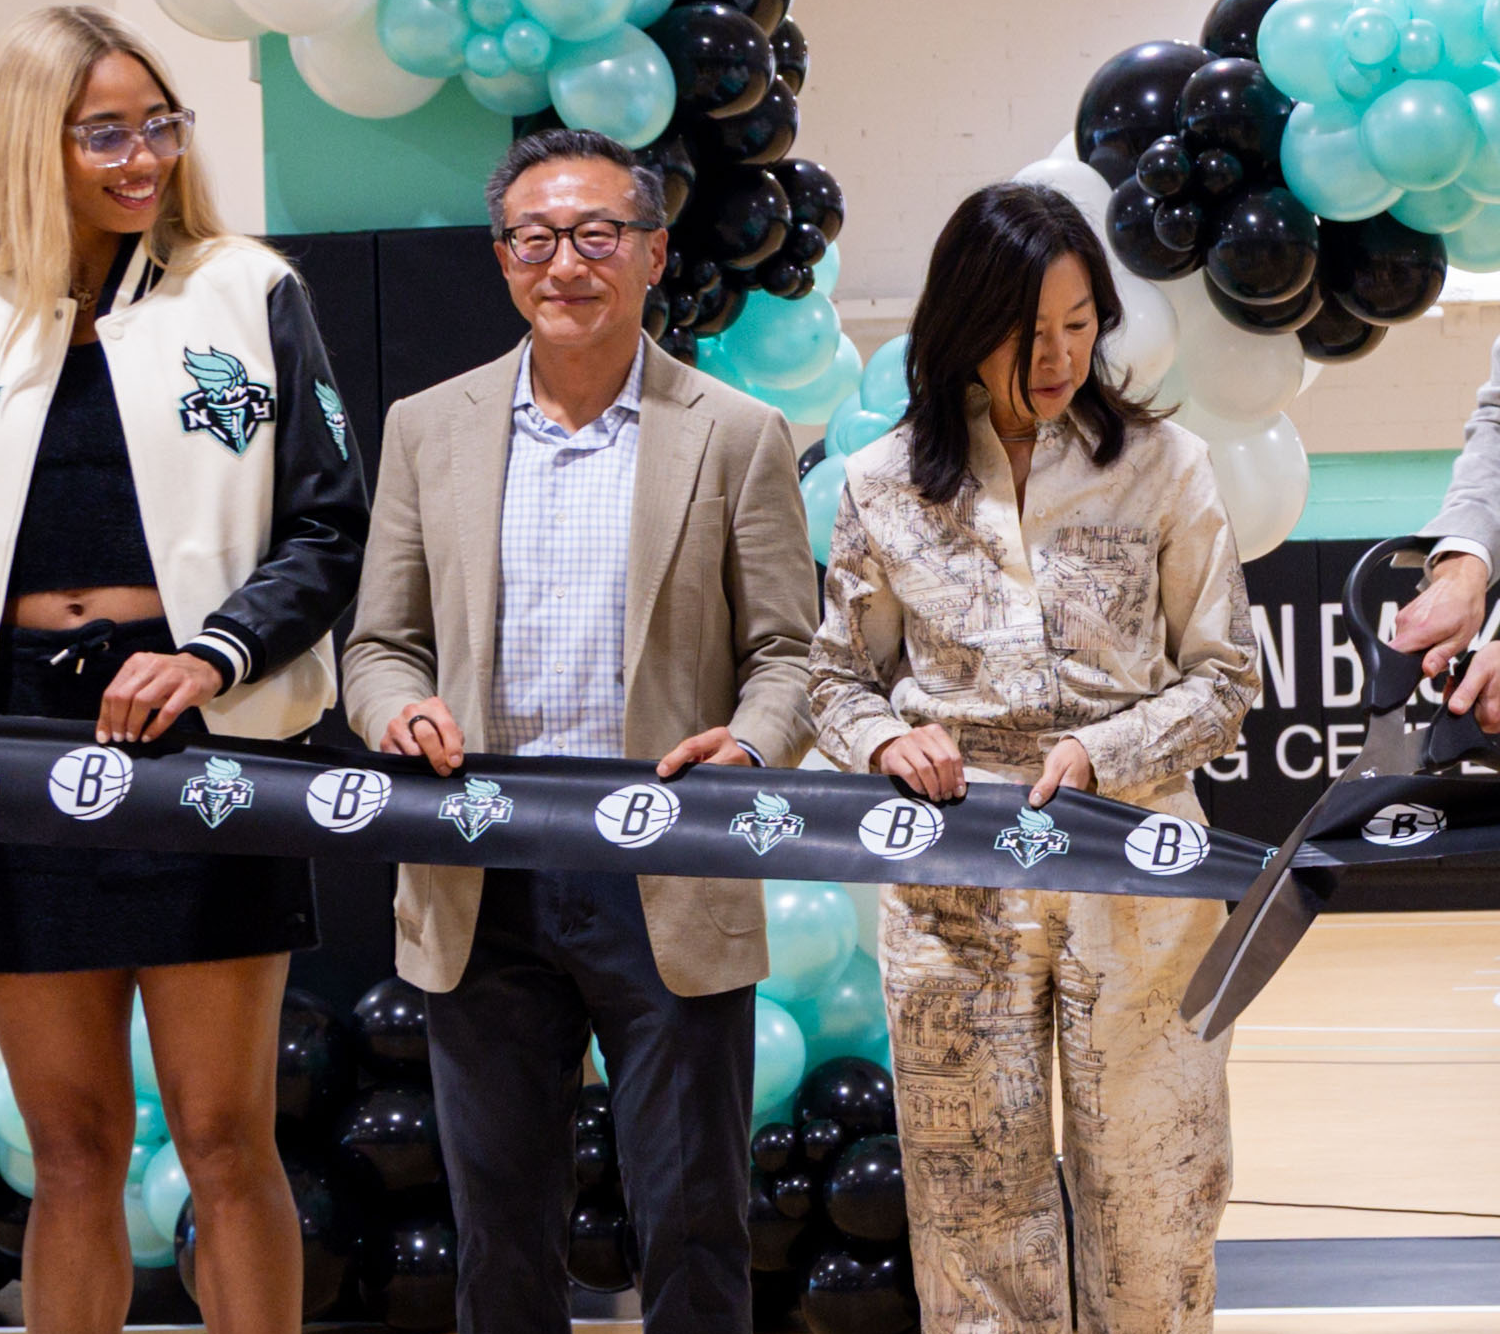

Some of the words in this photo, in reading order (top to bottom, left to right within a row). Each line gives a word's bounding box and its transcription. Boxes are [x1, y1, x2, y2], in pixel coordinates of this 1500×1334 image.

[75, 754, 107, 808] B
[332, 772, 367, 821] B
[620, 792, 654, 836] B
[885, 806, 917, 849] B
[1152, 822, 1182, 867] B
